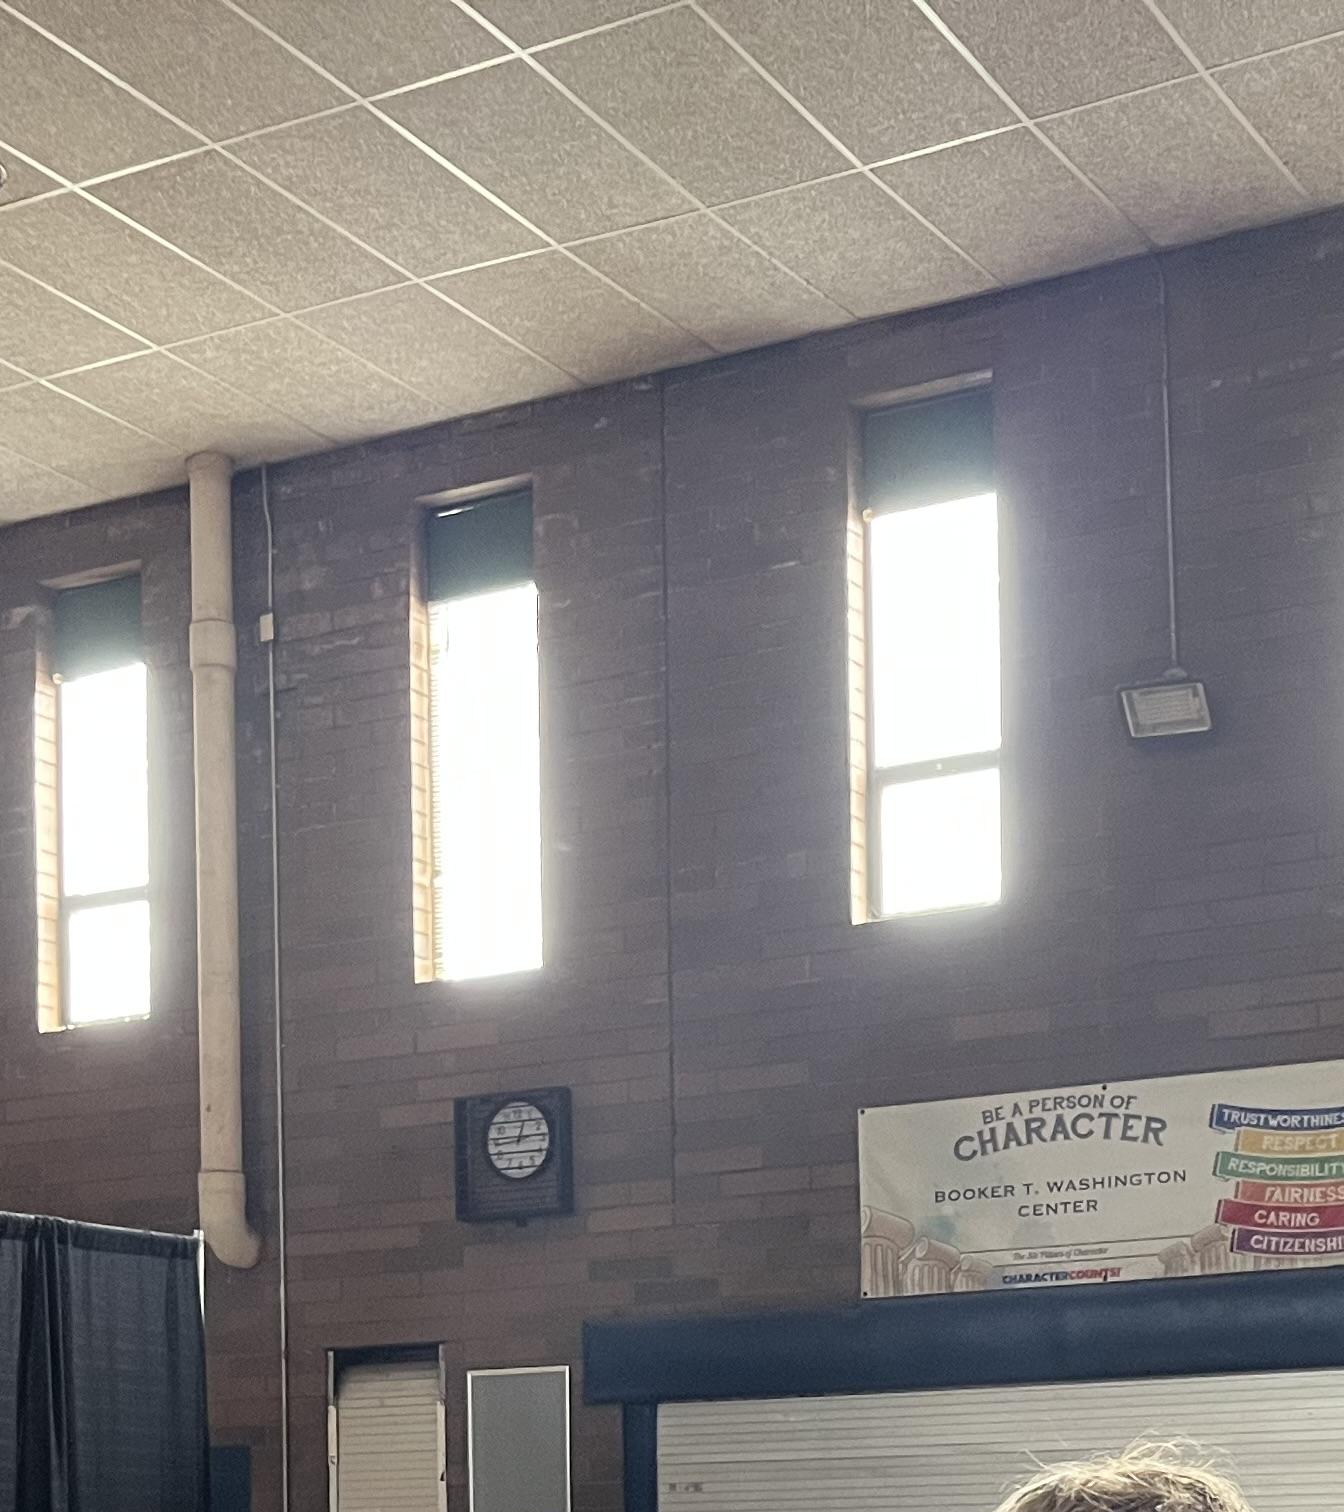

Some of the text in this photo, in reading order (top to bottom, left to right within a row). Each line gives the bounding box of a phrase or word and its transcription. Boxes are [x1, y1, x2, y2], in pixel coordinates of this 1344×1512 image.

[981, 1095, 1137, 1125] BE A PERSON OF
[953, 1112, 1167, 1162] CHARACTER
[1261, 1133, 1339, 1151] RESPECT
[935, 1169, 1186, 1203] BOOKER T. WASHINGTON
[1018, 1199, 1098, 1217] CENTER
[1254, 1209, 1320, 1227] CARING
